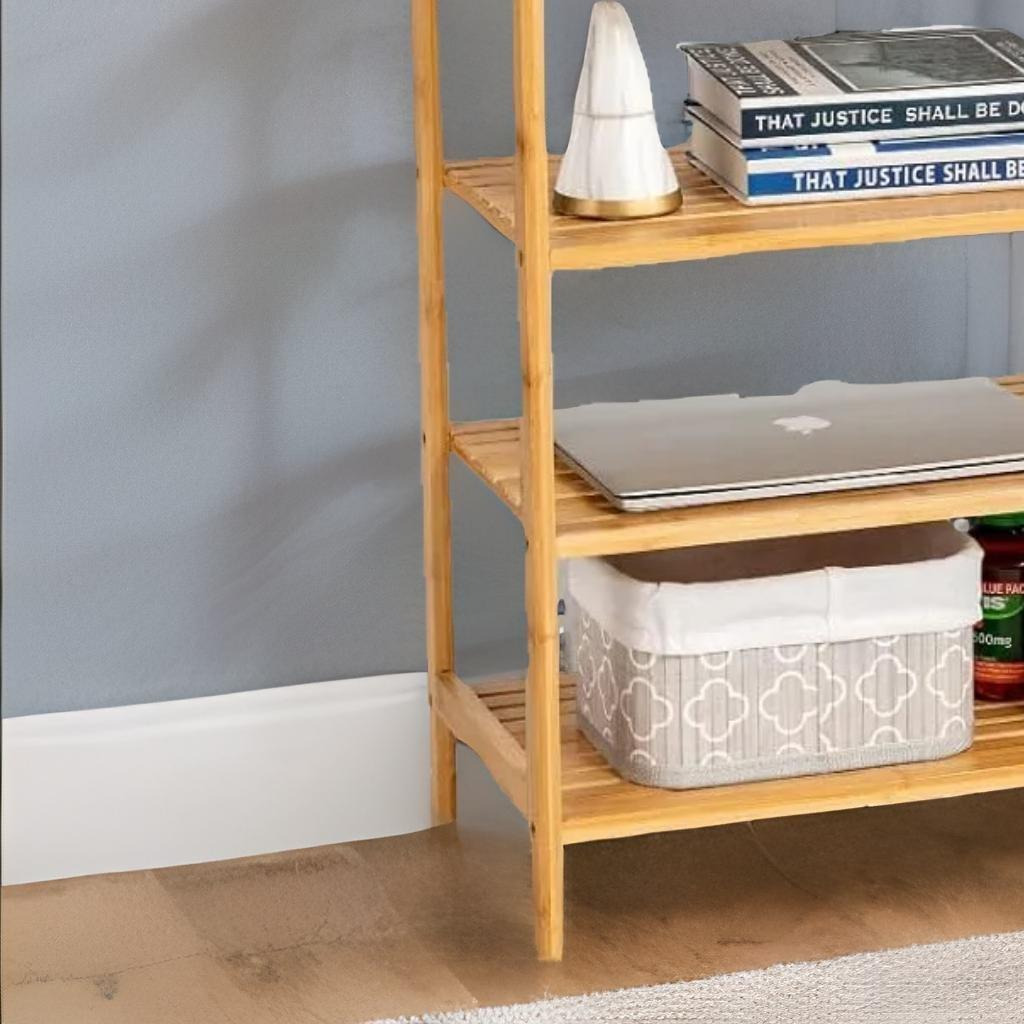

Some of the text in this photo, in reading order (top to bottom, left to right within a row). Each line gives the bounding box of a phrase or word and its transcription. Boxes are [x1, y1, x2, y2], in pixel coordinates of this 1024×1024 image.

[755, 112, 805, 131] THAT
[811, 108, 893, 127] JUSTICE
[905, 104, 968, 122] SHALL
[975, 101, 1001, 118] BE
[793, 170, 848, 191] THAT
[854, 165, 936, 188] JUSTICE
[943, 161, 1001, 182] SHALL
[983, 582, 1003, 594] LUE
